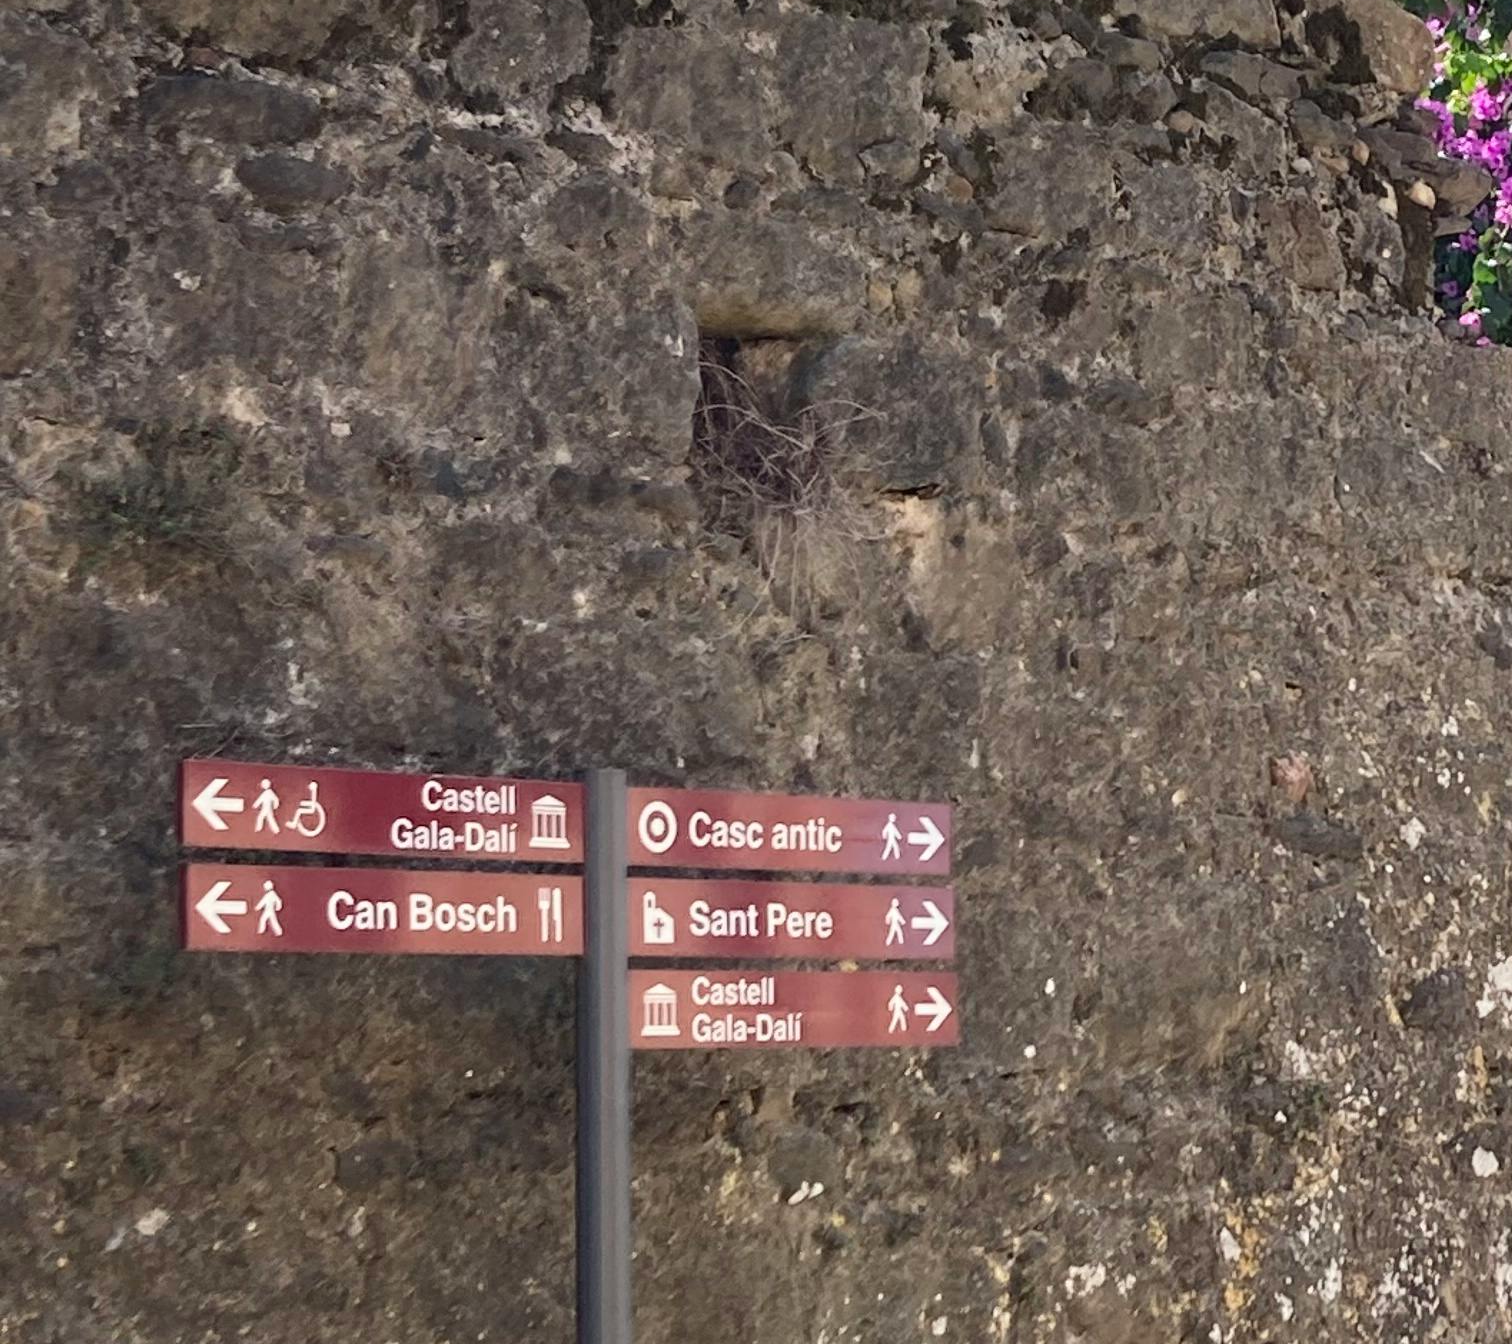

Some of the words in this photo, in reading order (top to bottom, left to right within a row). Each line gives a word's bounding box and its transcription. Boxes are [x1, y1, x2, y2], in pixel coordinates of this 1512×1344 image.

[421, 780, 516, 815] Castell
[391, 818, 518, 853] Gala-Dalí
[688, 811, 764, 849] Casc
[771, 817, 842, 853] antic
[327, 890, 398, 930] Can
[408, 893, 517, 933] Bosch
[688, 900, 759, 937] Sant
[766, 902, 833, 939] Pere
[690, 975, 775, 1006] Castell
[691, 1012, 803, 1043] Gala-Dalí
